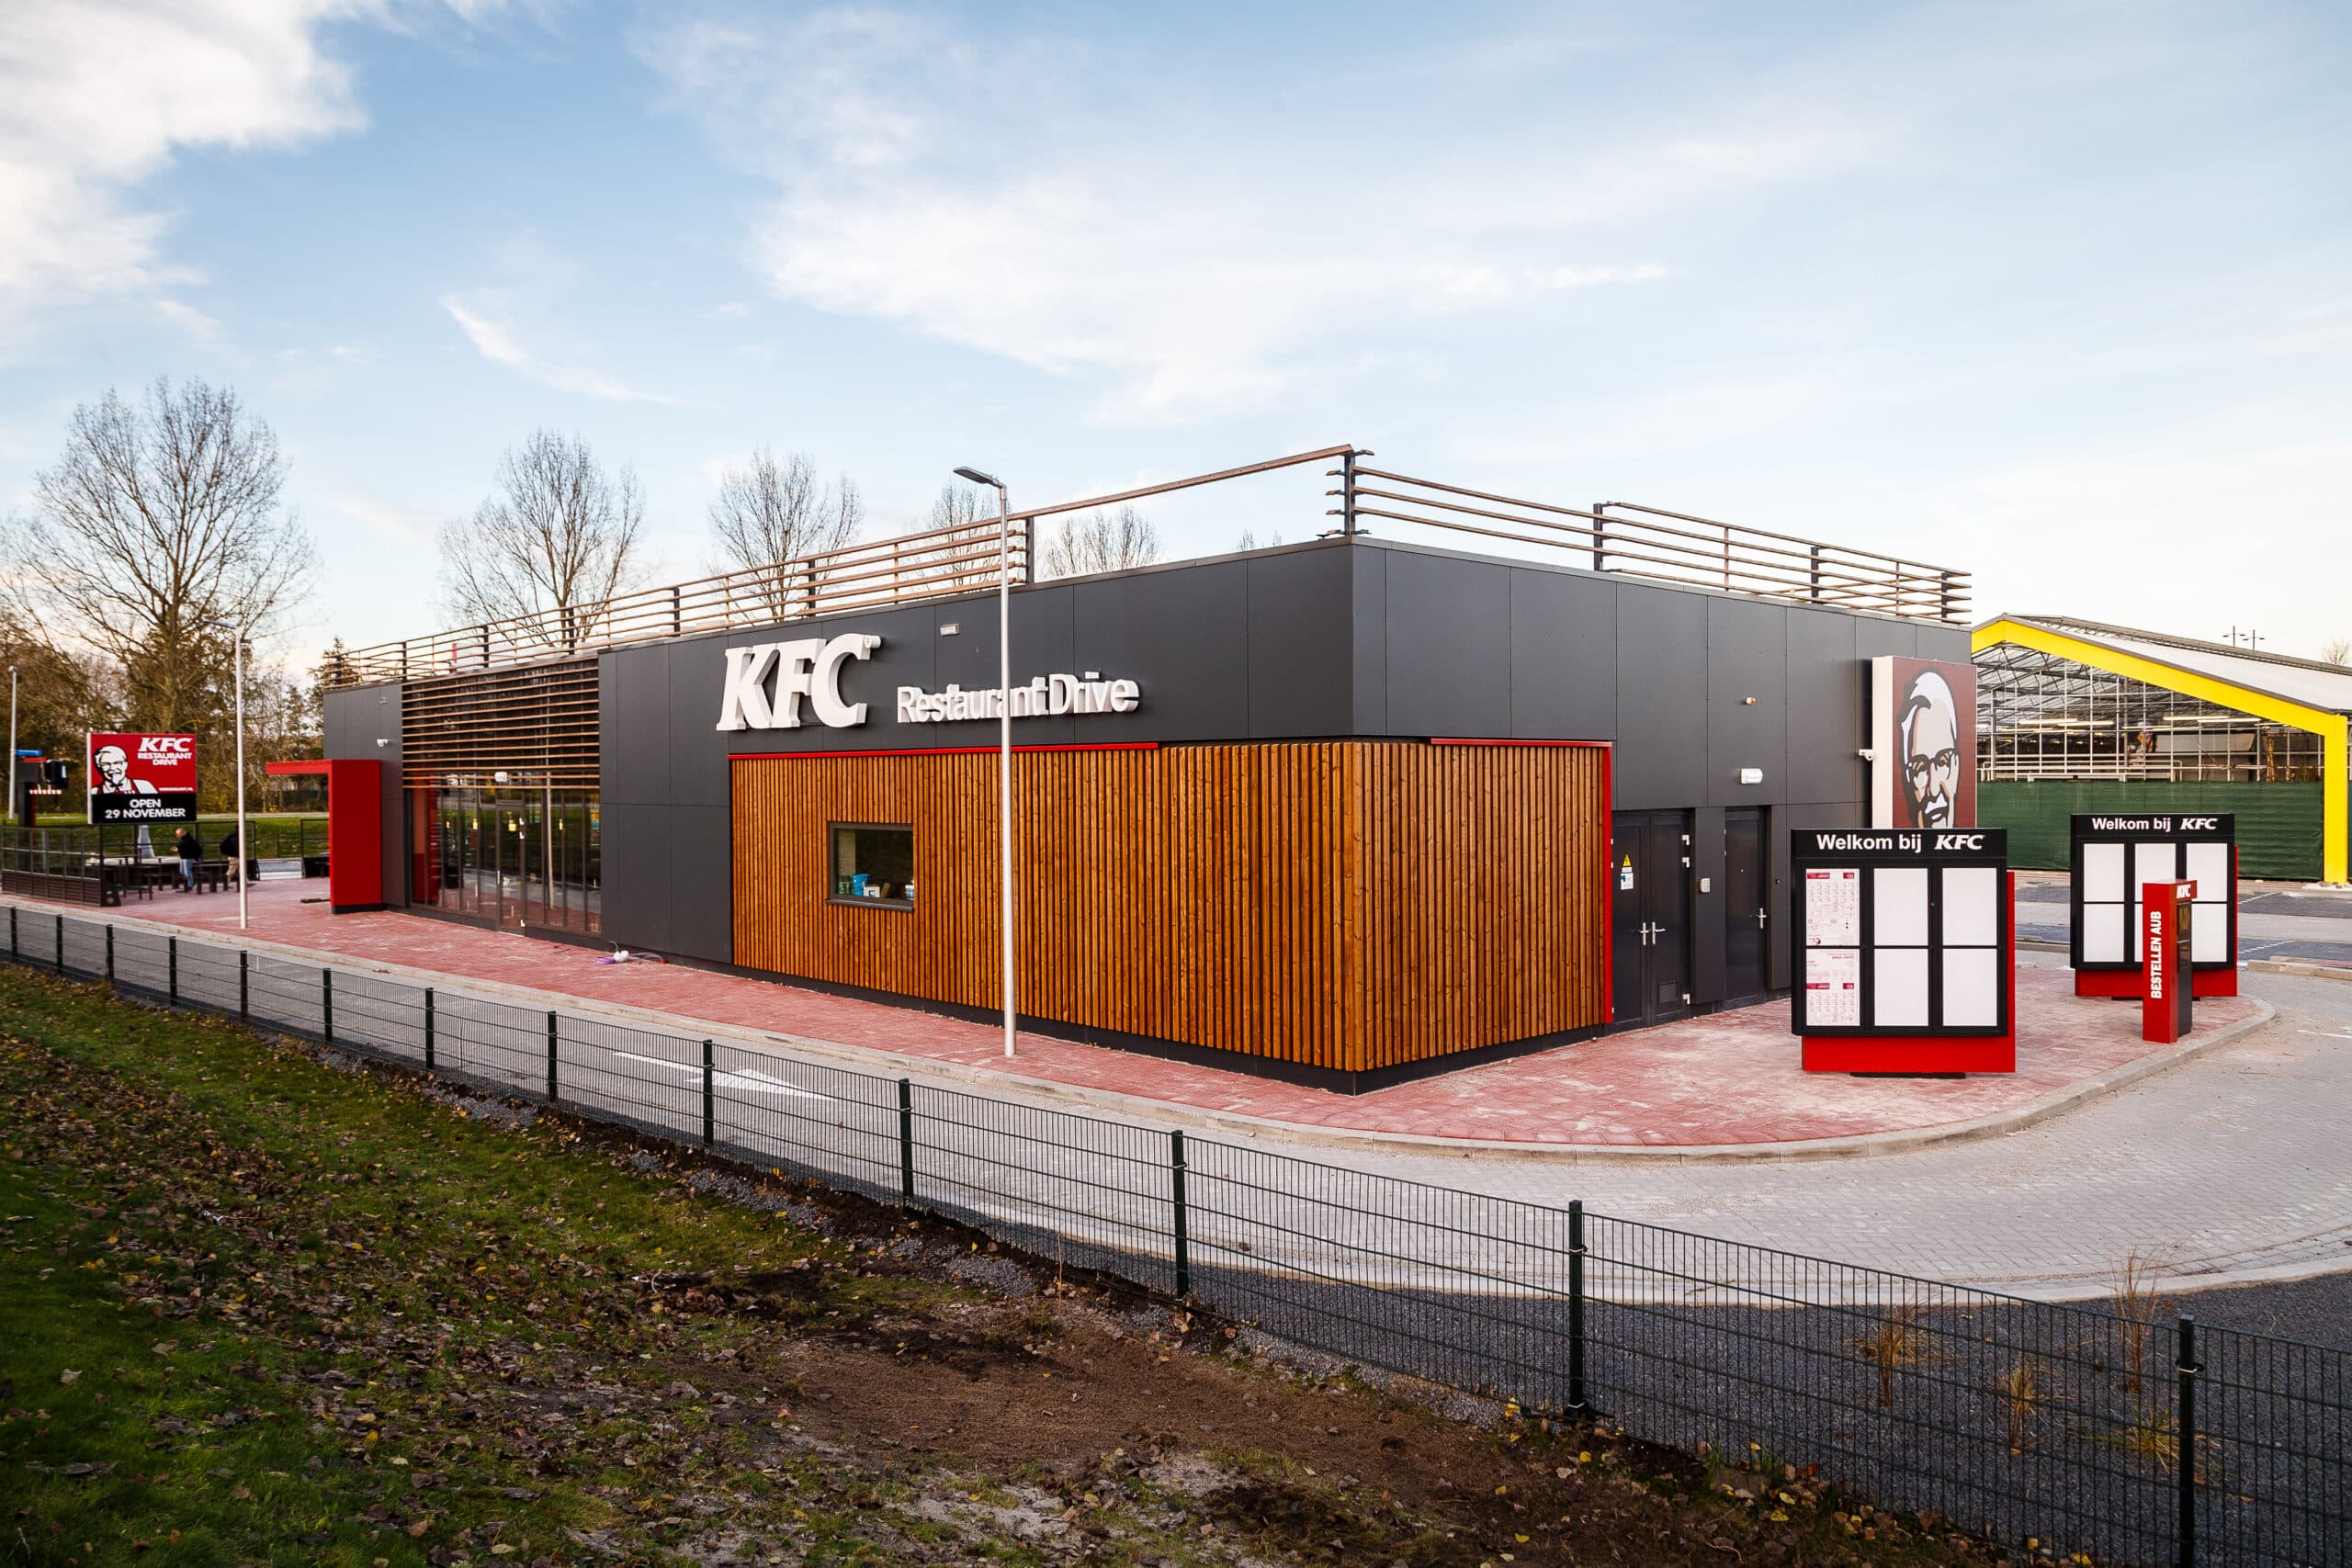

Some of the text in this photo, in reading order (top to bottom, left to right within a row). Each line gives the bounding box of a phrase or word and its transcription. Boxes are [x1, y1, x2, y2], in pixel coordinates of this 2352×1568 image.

[716, 633, 882, 731] KFC
[1048, 671, 1140, 715] Drive
[138, 738, 193, 752] KFC
[130, 798, 162, 808] OPEN
[105, 808, 186, 818] 29 NOVEMBER
[2091, 818, 2219, 832] Welkom bij KFC
[1816, 834, 1985, 853] Welkom bij KFC
[2150, 911, 2163, 998] BESTELLEN AUB
